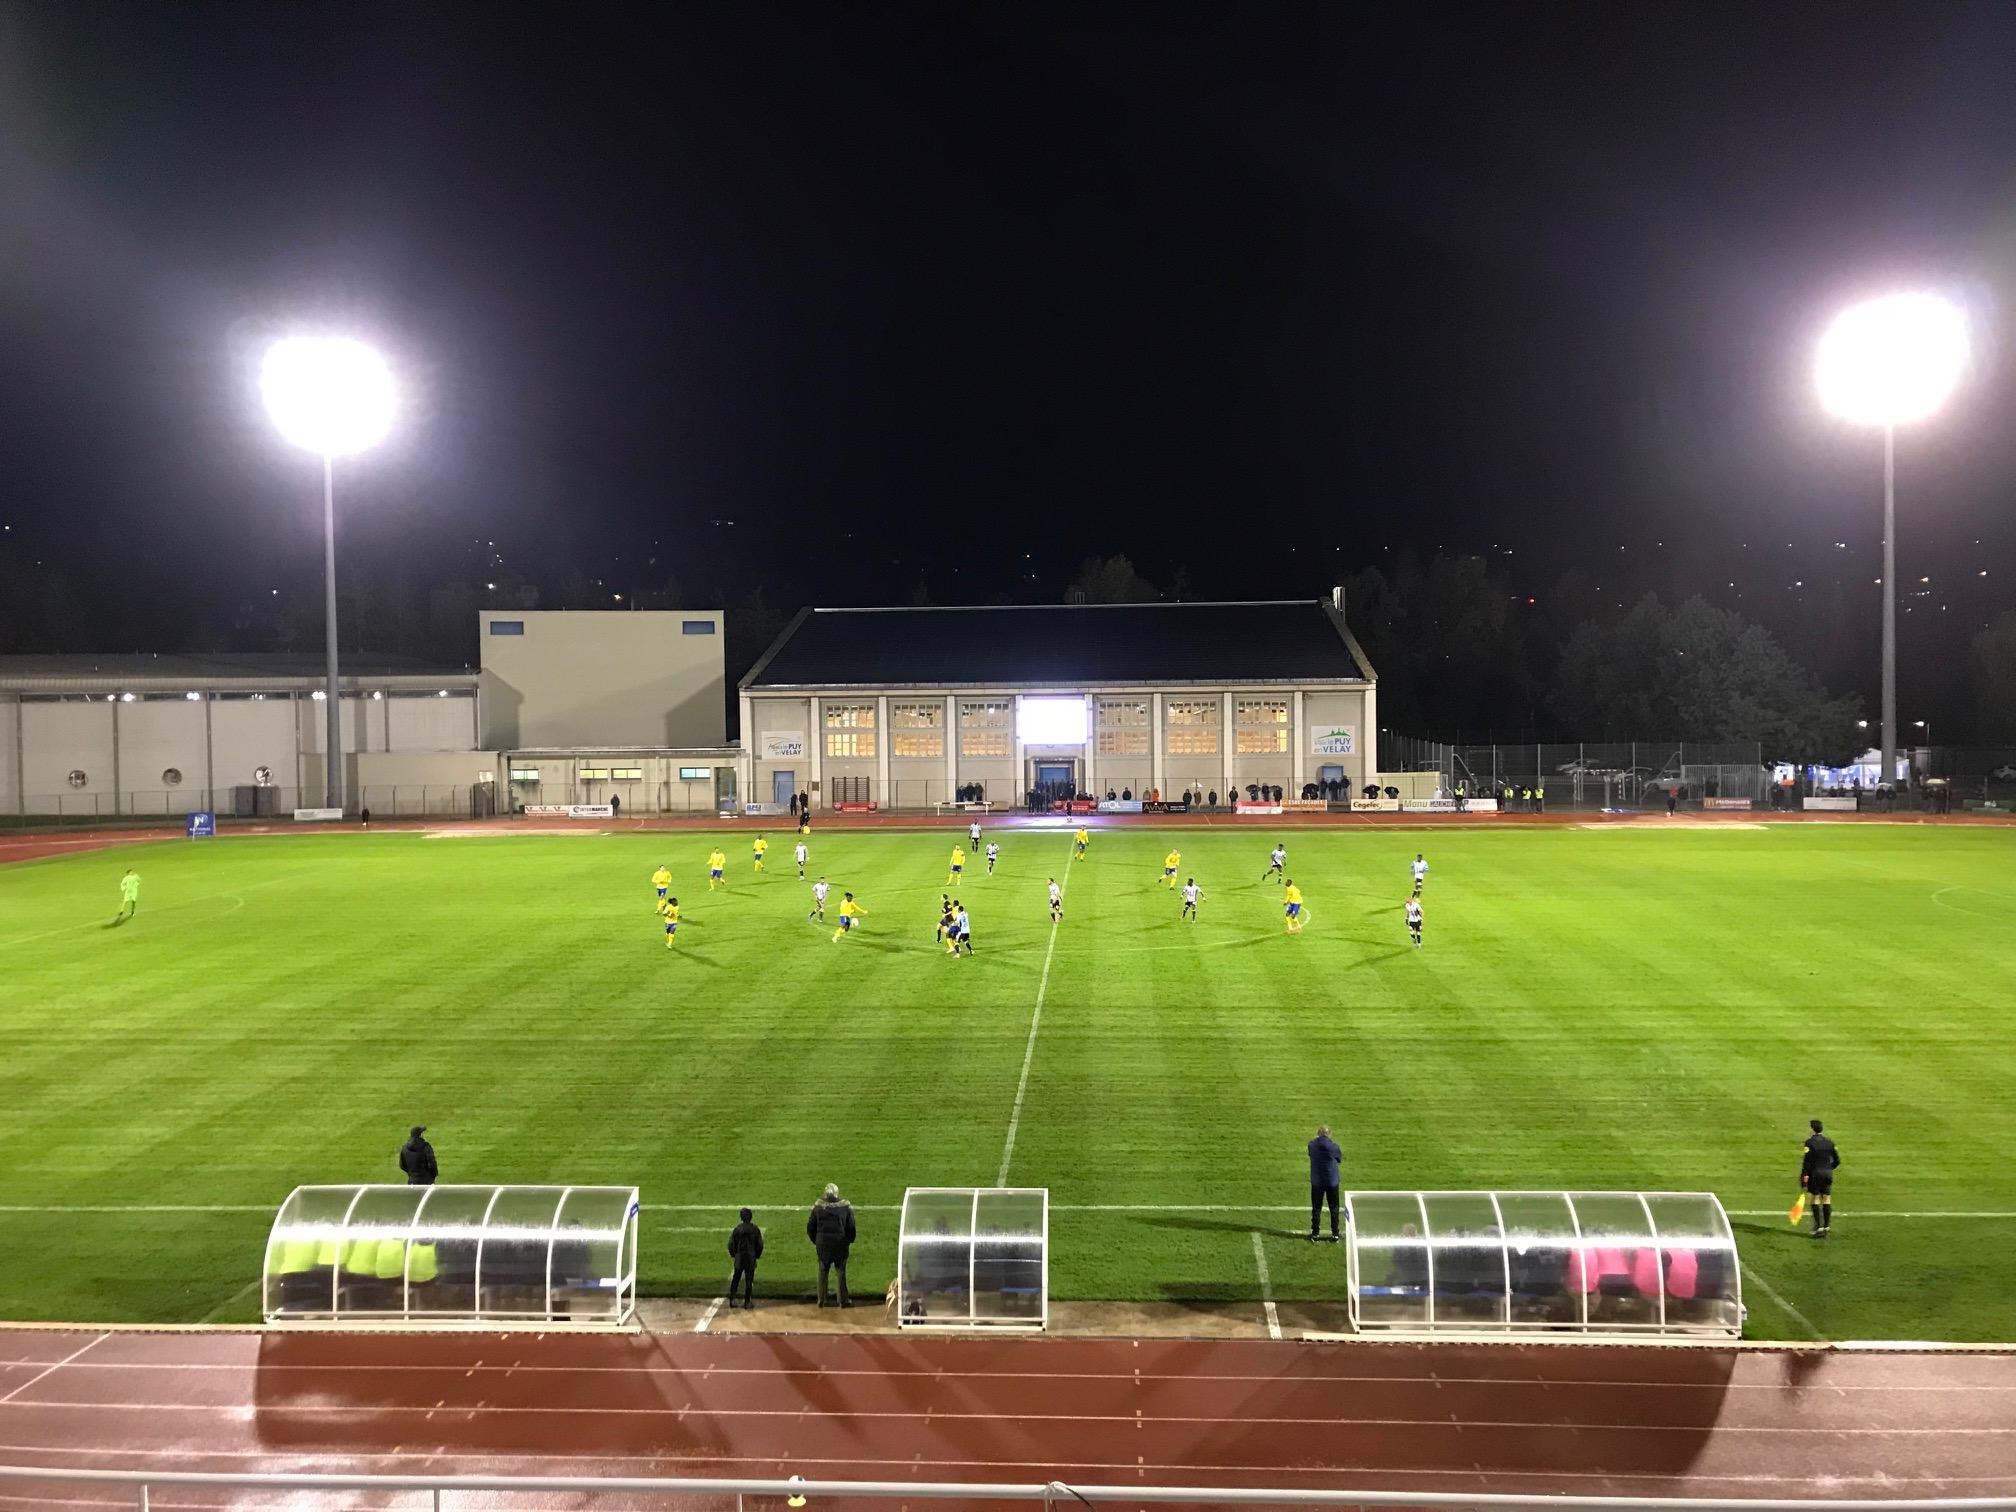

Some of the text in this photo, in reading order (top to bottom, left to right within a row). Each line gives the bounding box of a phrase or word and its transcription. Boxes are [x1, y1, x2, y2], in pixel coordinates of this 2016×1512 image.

[1334, 737, 1351, 745] PUY
[1322, 745, 1351, 753] VELAY
[1099, 801, 1120, 809] ATOL
[1352, 801, 1380, 810] Cegelec
